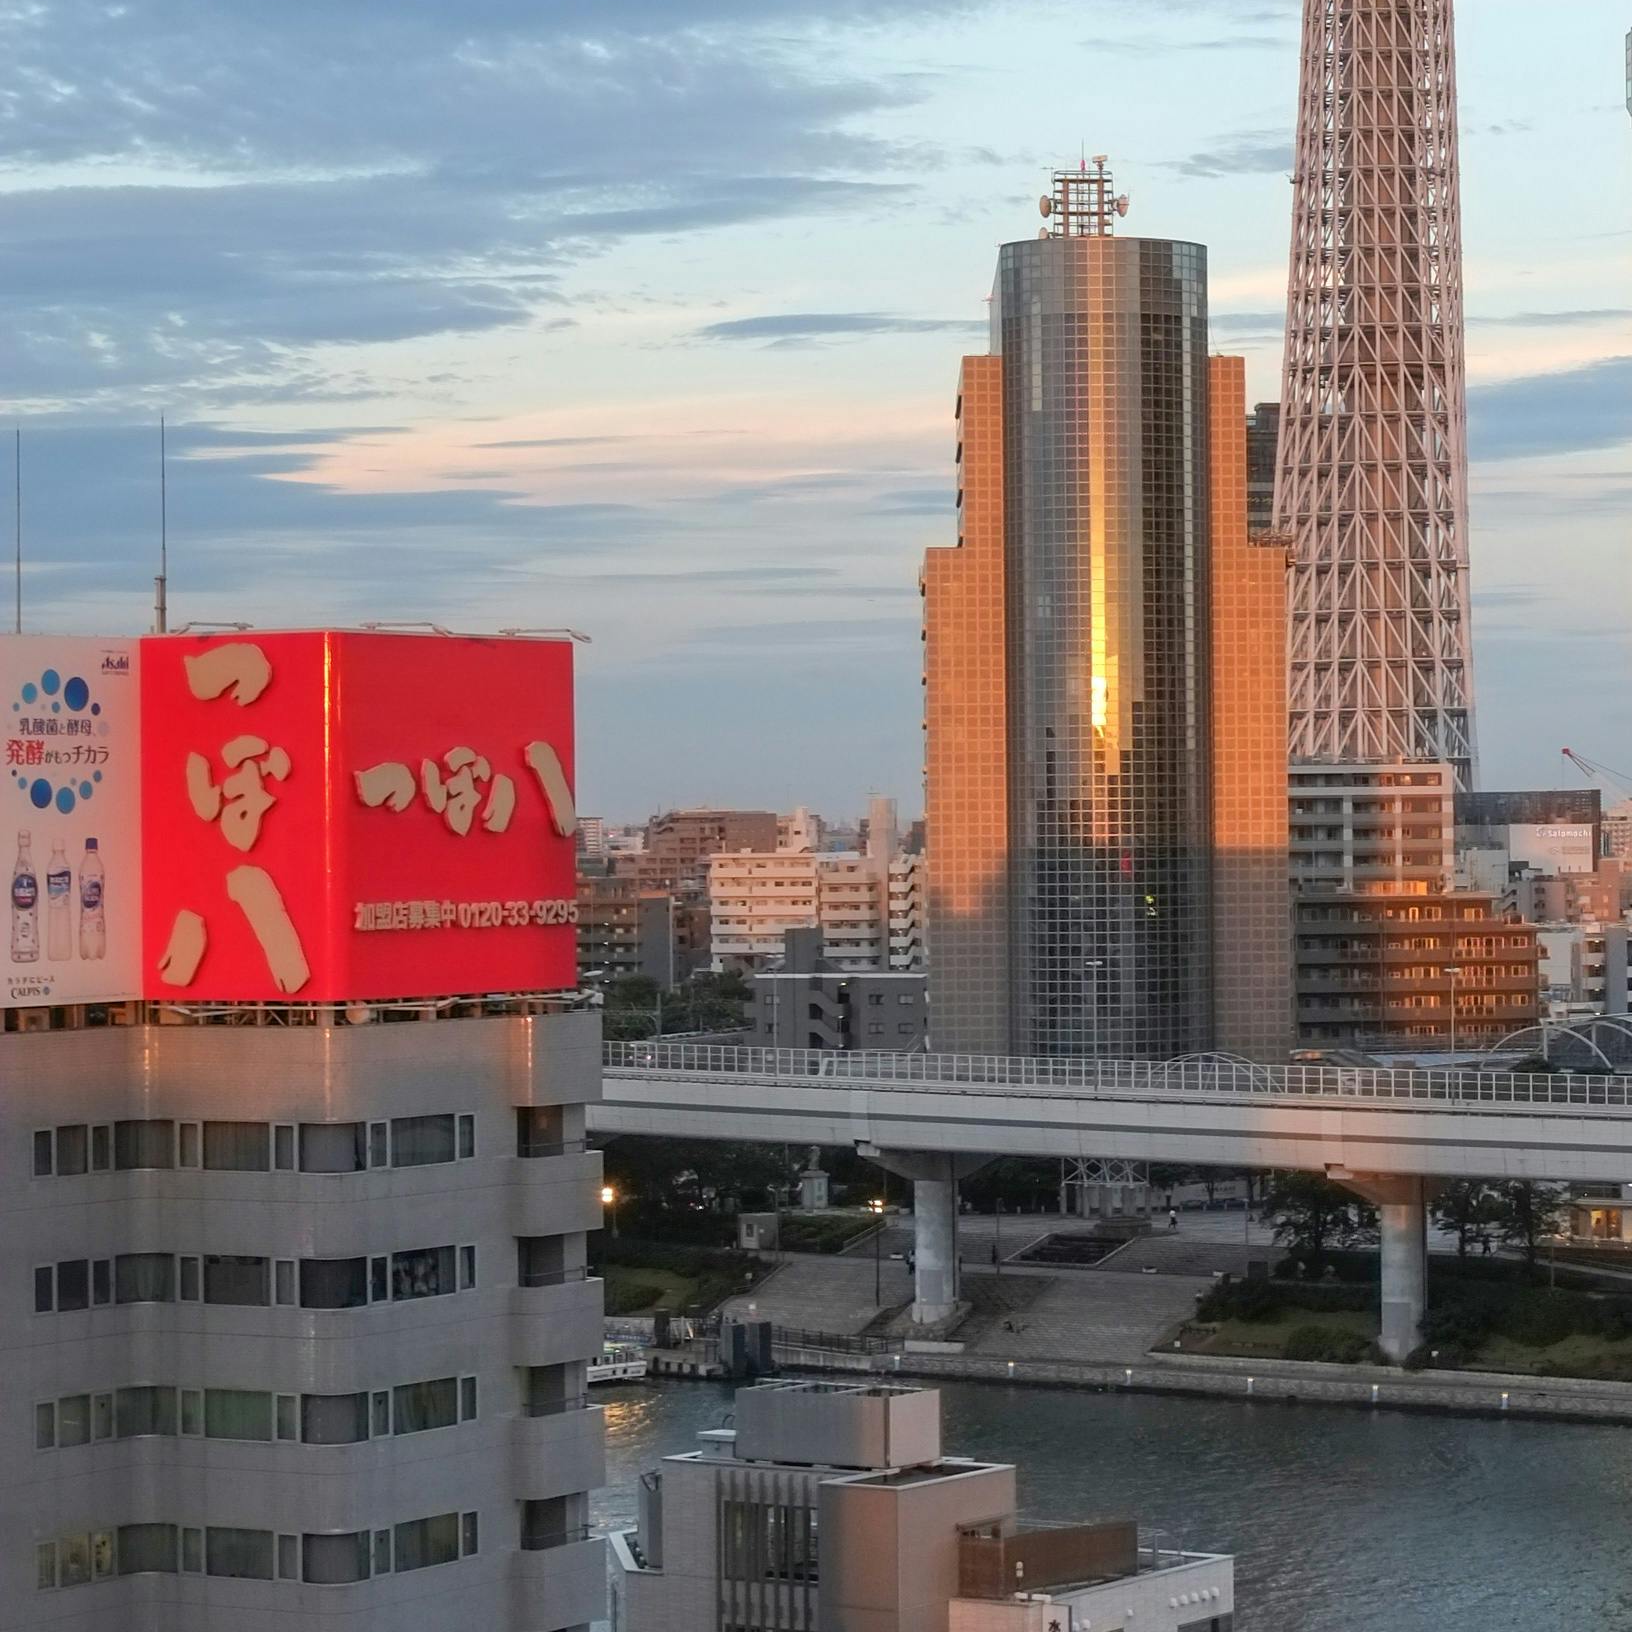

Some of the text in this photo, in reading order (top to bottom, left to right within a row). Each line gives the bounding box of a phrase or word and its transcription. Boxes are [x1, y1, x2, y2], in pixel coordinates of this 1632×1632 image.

[6, 739, 110, 765] 発酵がもつチカラ
[158, 643, 310, 993] つぼ八
[353, 741, 576, 837] つぼ八
[458, 900, 579, 928] 0120-33-9295
